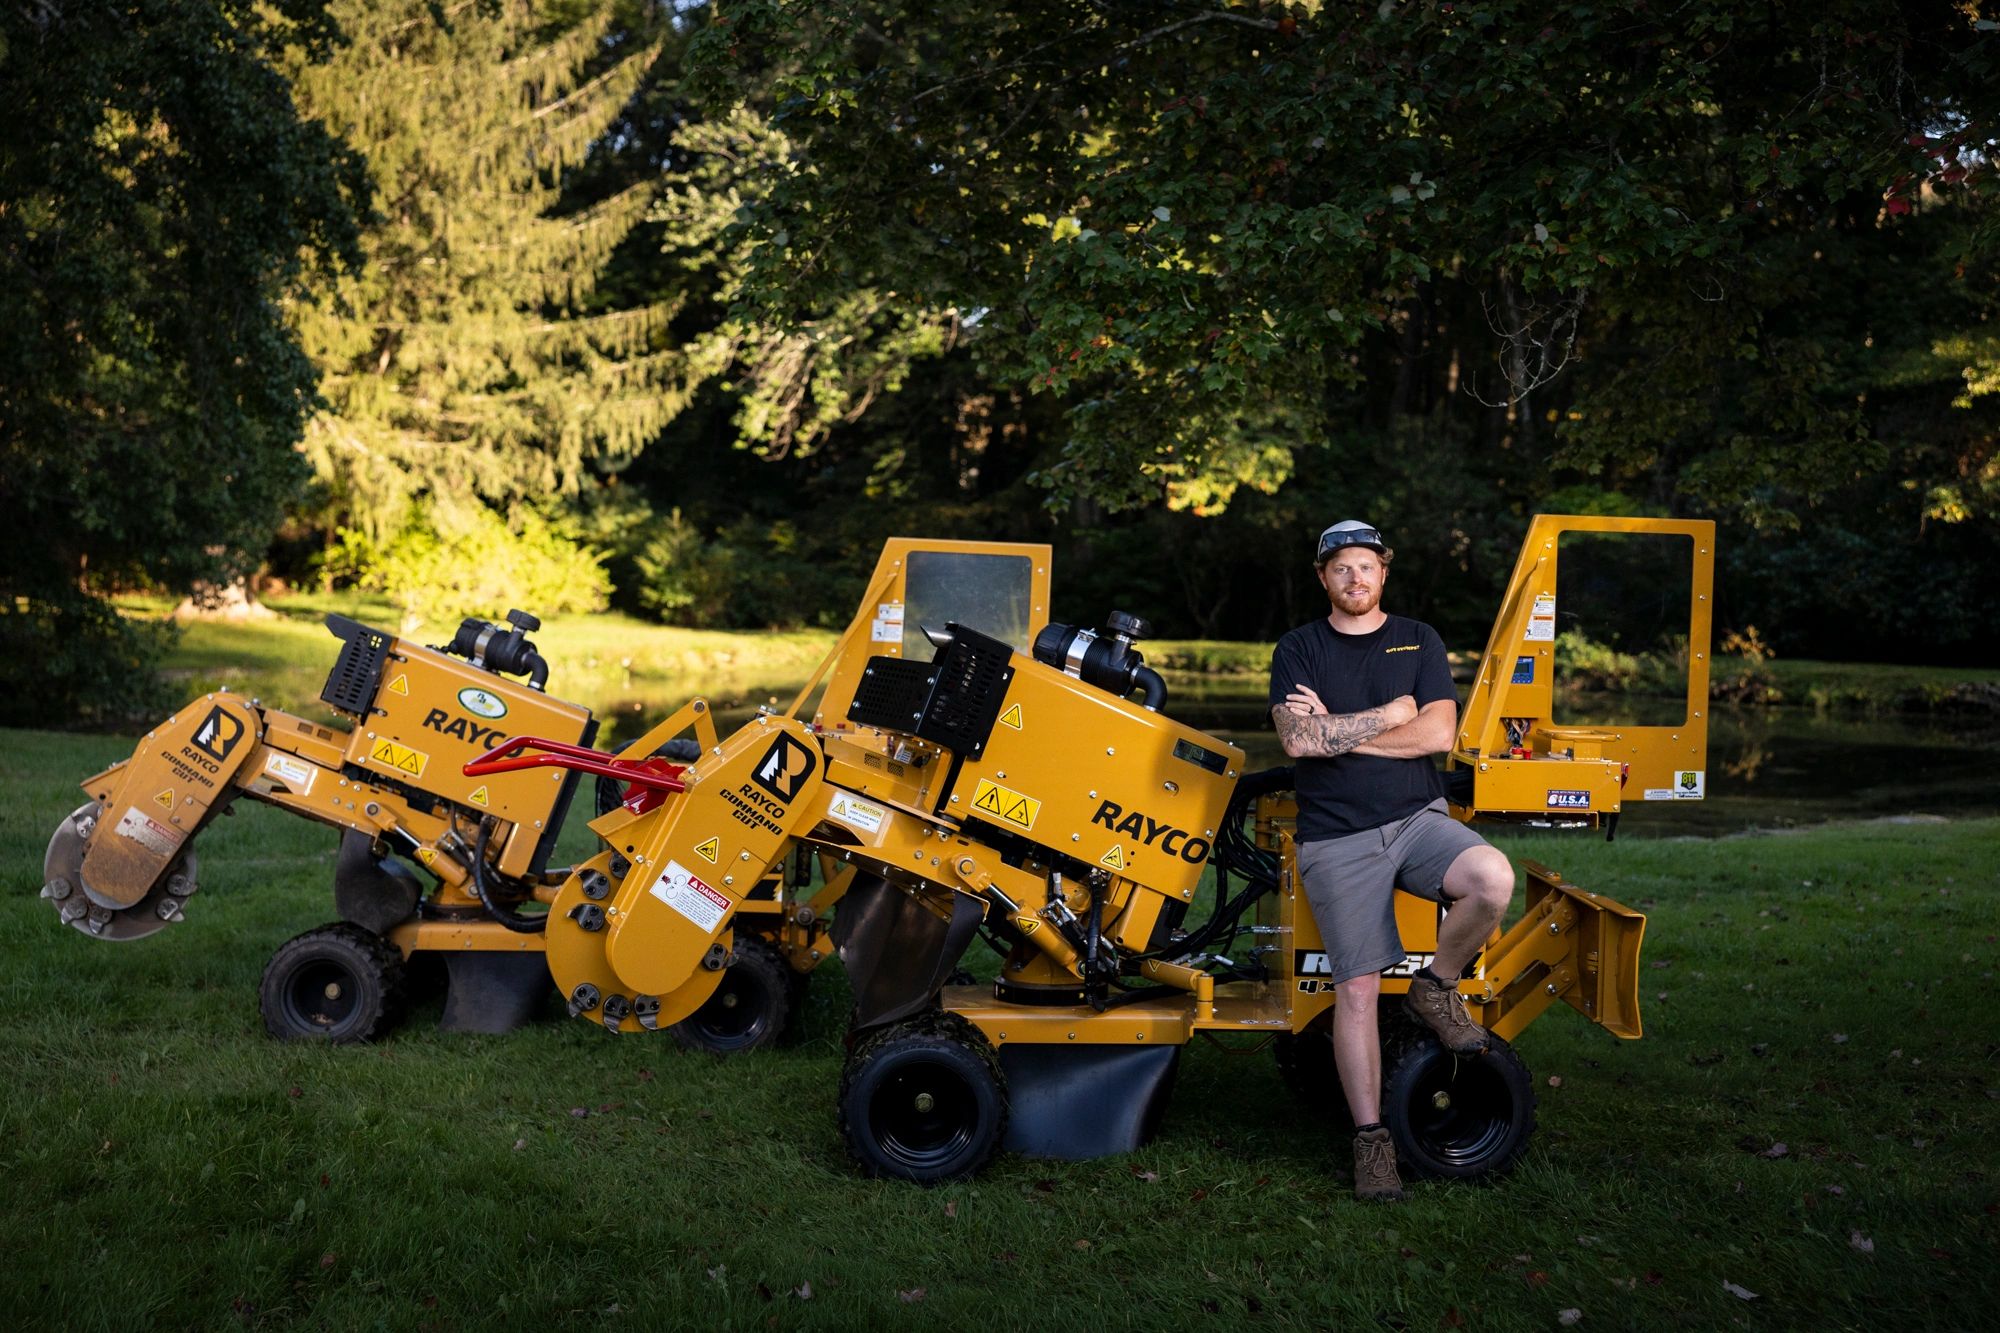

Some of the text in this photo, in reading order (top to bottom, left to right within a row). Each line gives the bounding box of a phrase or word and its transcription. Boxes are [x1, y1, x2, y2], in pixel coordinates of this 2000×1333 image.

[161, 751, 215, 788] COMMAND
[181, 746, 220, 774] RAYCO
[172, 767, 195, 784] CUT
[1682, 773, 1696, 784] 811
[739, 784, 785, 819] RAYCO
[858, 804, 882, 817] CAUTION
[1558, 795, 1589, 805] U.S.A.
[719, 789, 784, 836] COMMAND
[732, 809, 760, 830] CUT
[1091, 799, 1210, 864] RAYCO
[698, 884, 727, 908] DANGER
